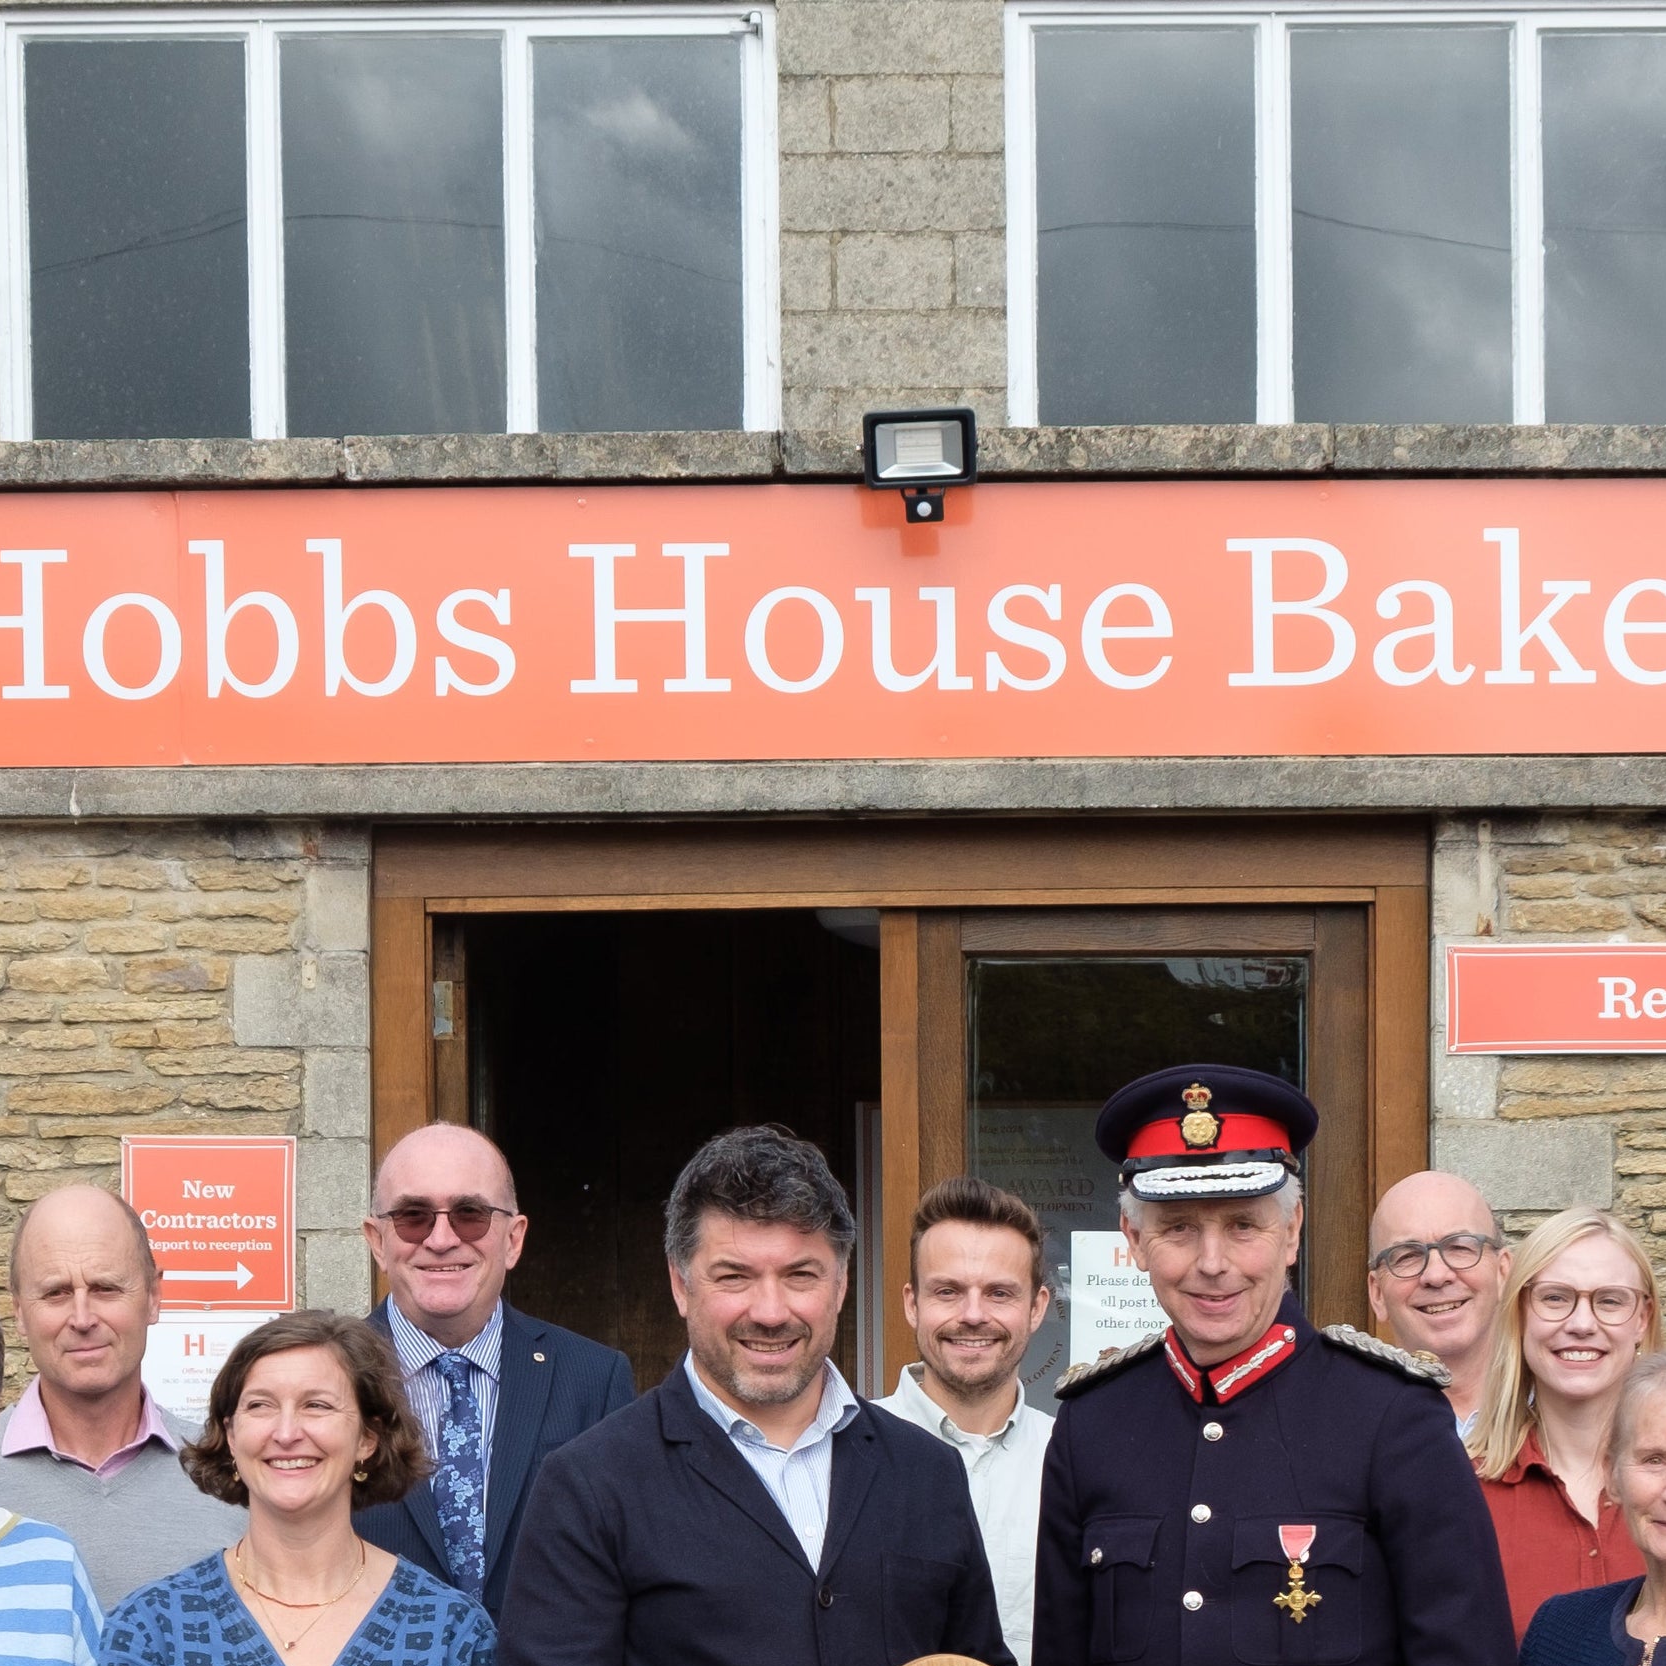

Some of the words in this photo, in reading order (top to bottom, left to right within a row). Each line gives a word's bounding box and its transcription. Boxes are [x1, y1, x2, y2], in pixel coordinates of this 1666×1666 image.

[568, 542, 1174, 694] House
[182, 1179, 236, 1199] New
[140, 1209, 278, 1229] Contractors
[148, 1238, 190, 1252] Report
[192, 1239, 207, 1251] to
[209, 1239, 273, 1253] reception
[1086, 1273, 1129, 1286] Please
[1100, 1296, 1117, 1308] all
[1119, 1298, 1149, 1310] post
[1095, 1317, 1131, 1329] other
[1133, 1317, 1166, 1329] door
